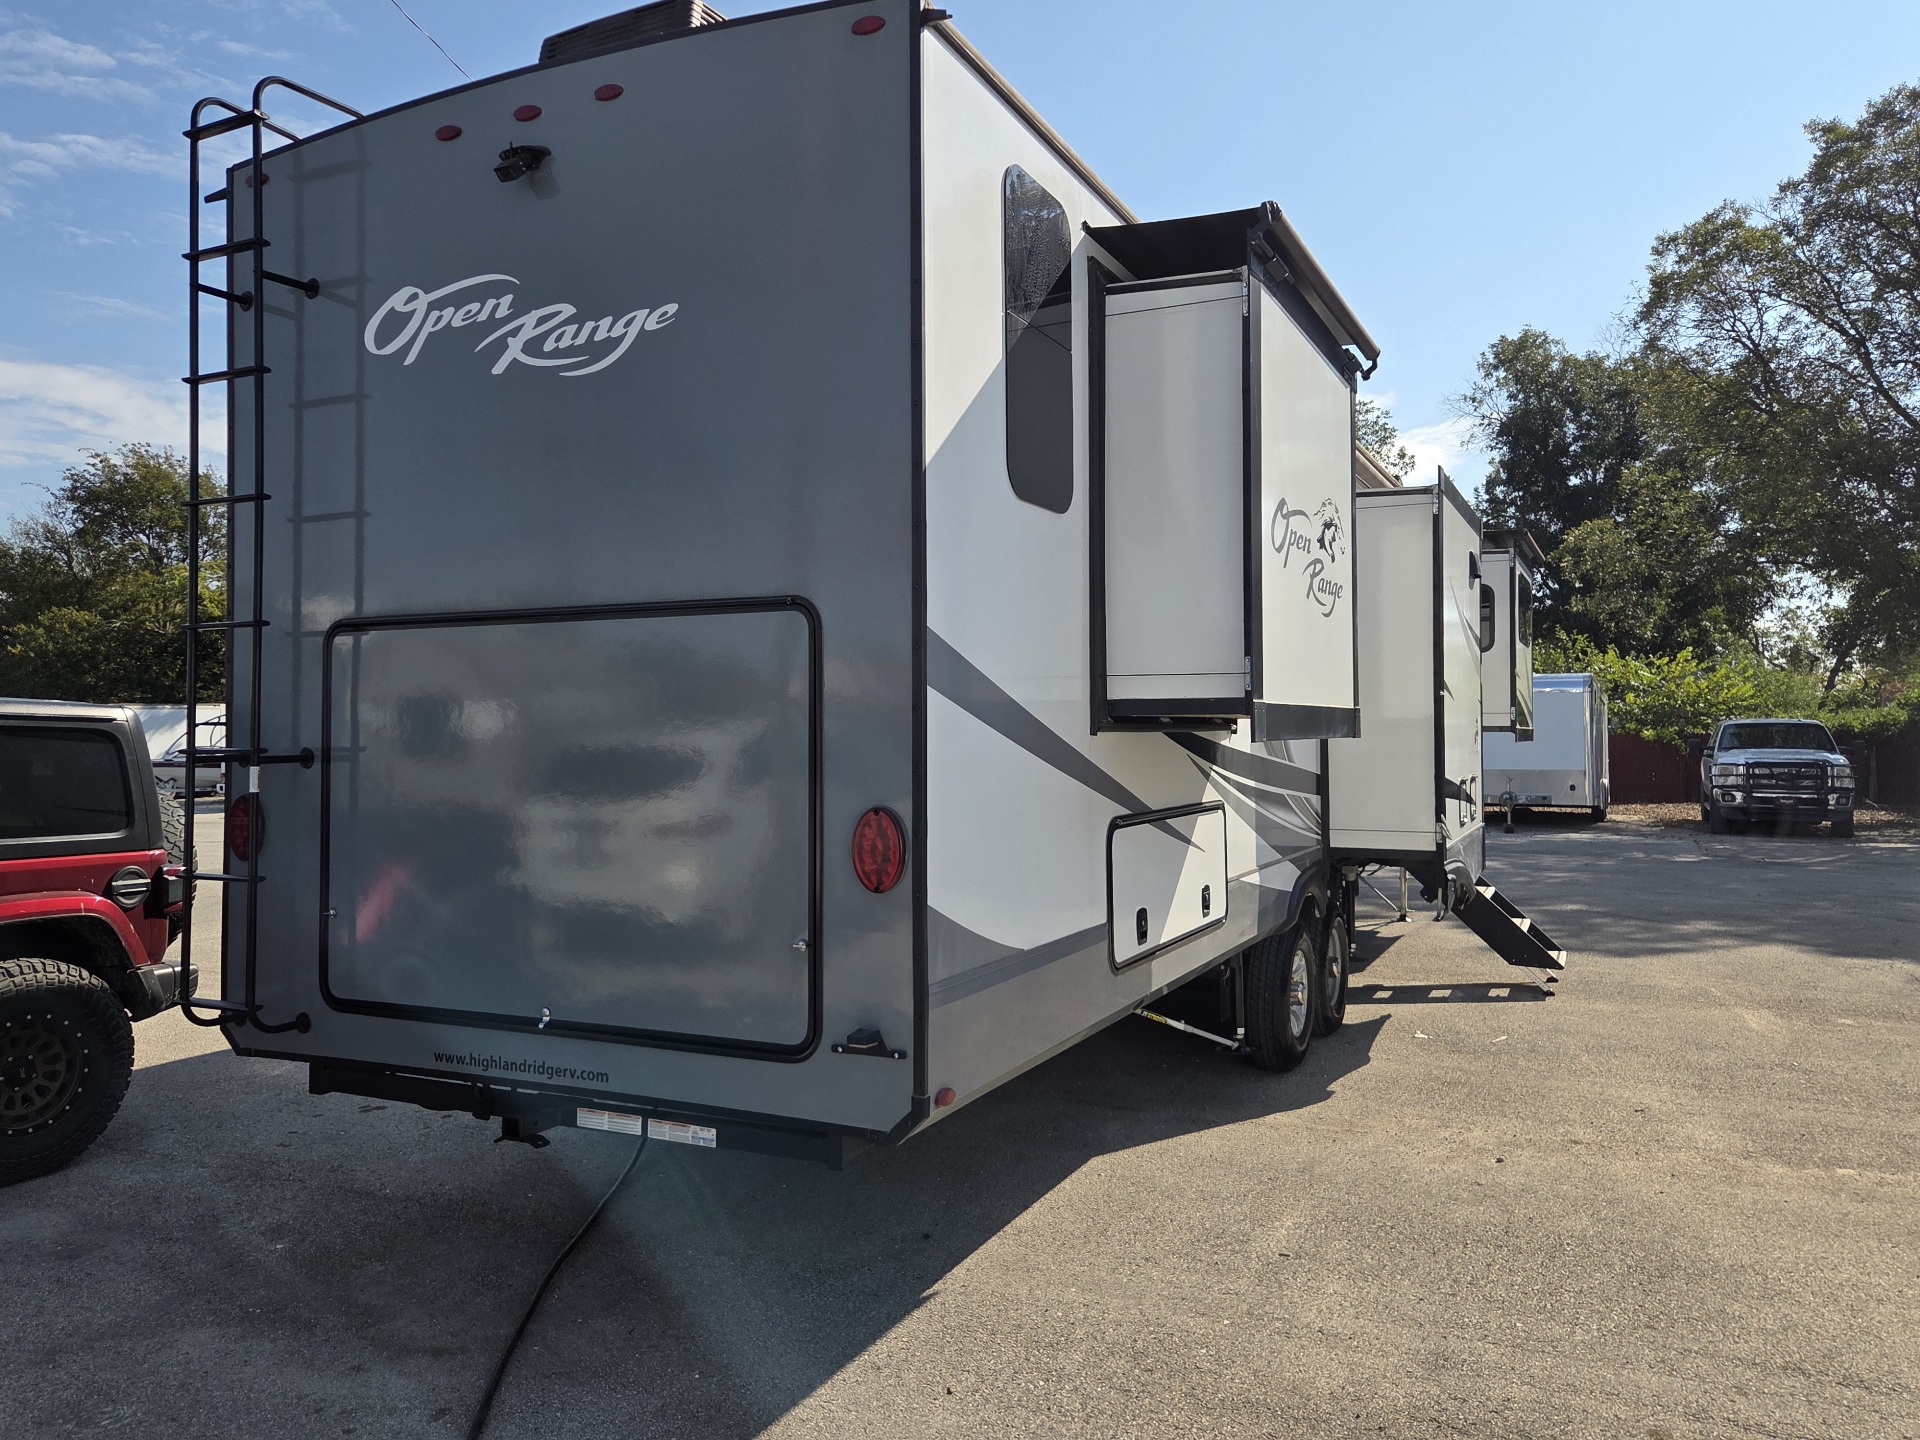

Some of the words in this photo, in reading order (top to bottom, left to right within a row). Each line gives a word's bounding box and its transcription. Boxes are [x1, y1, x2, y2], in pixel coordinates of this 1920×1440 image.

[364, 274, 520, 366] Open
[474, 303, 679, 376] Range
[1271, 497, 1312, 569] Open
[1302, 557, 1344, 618] Range
[433, 1051, 609, 1083] www.highlandridgerv.com
